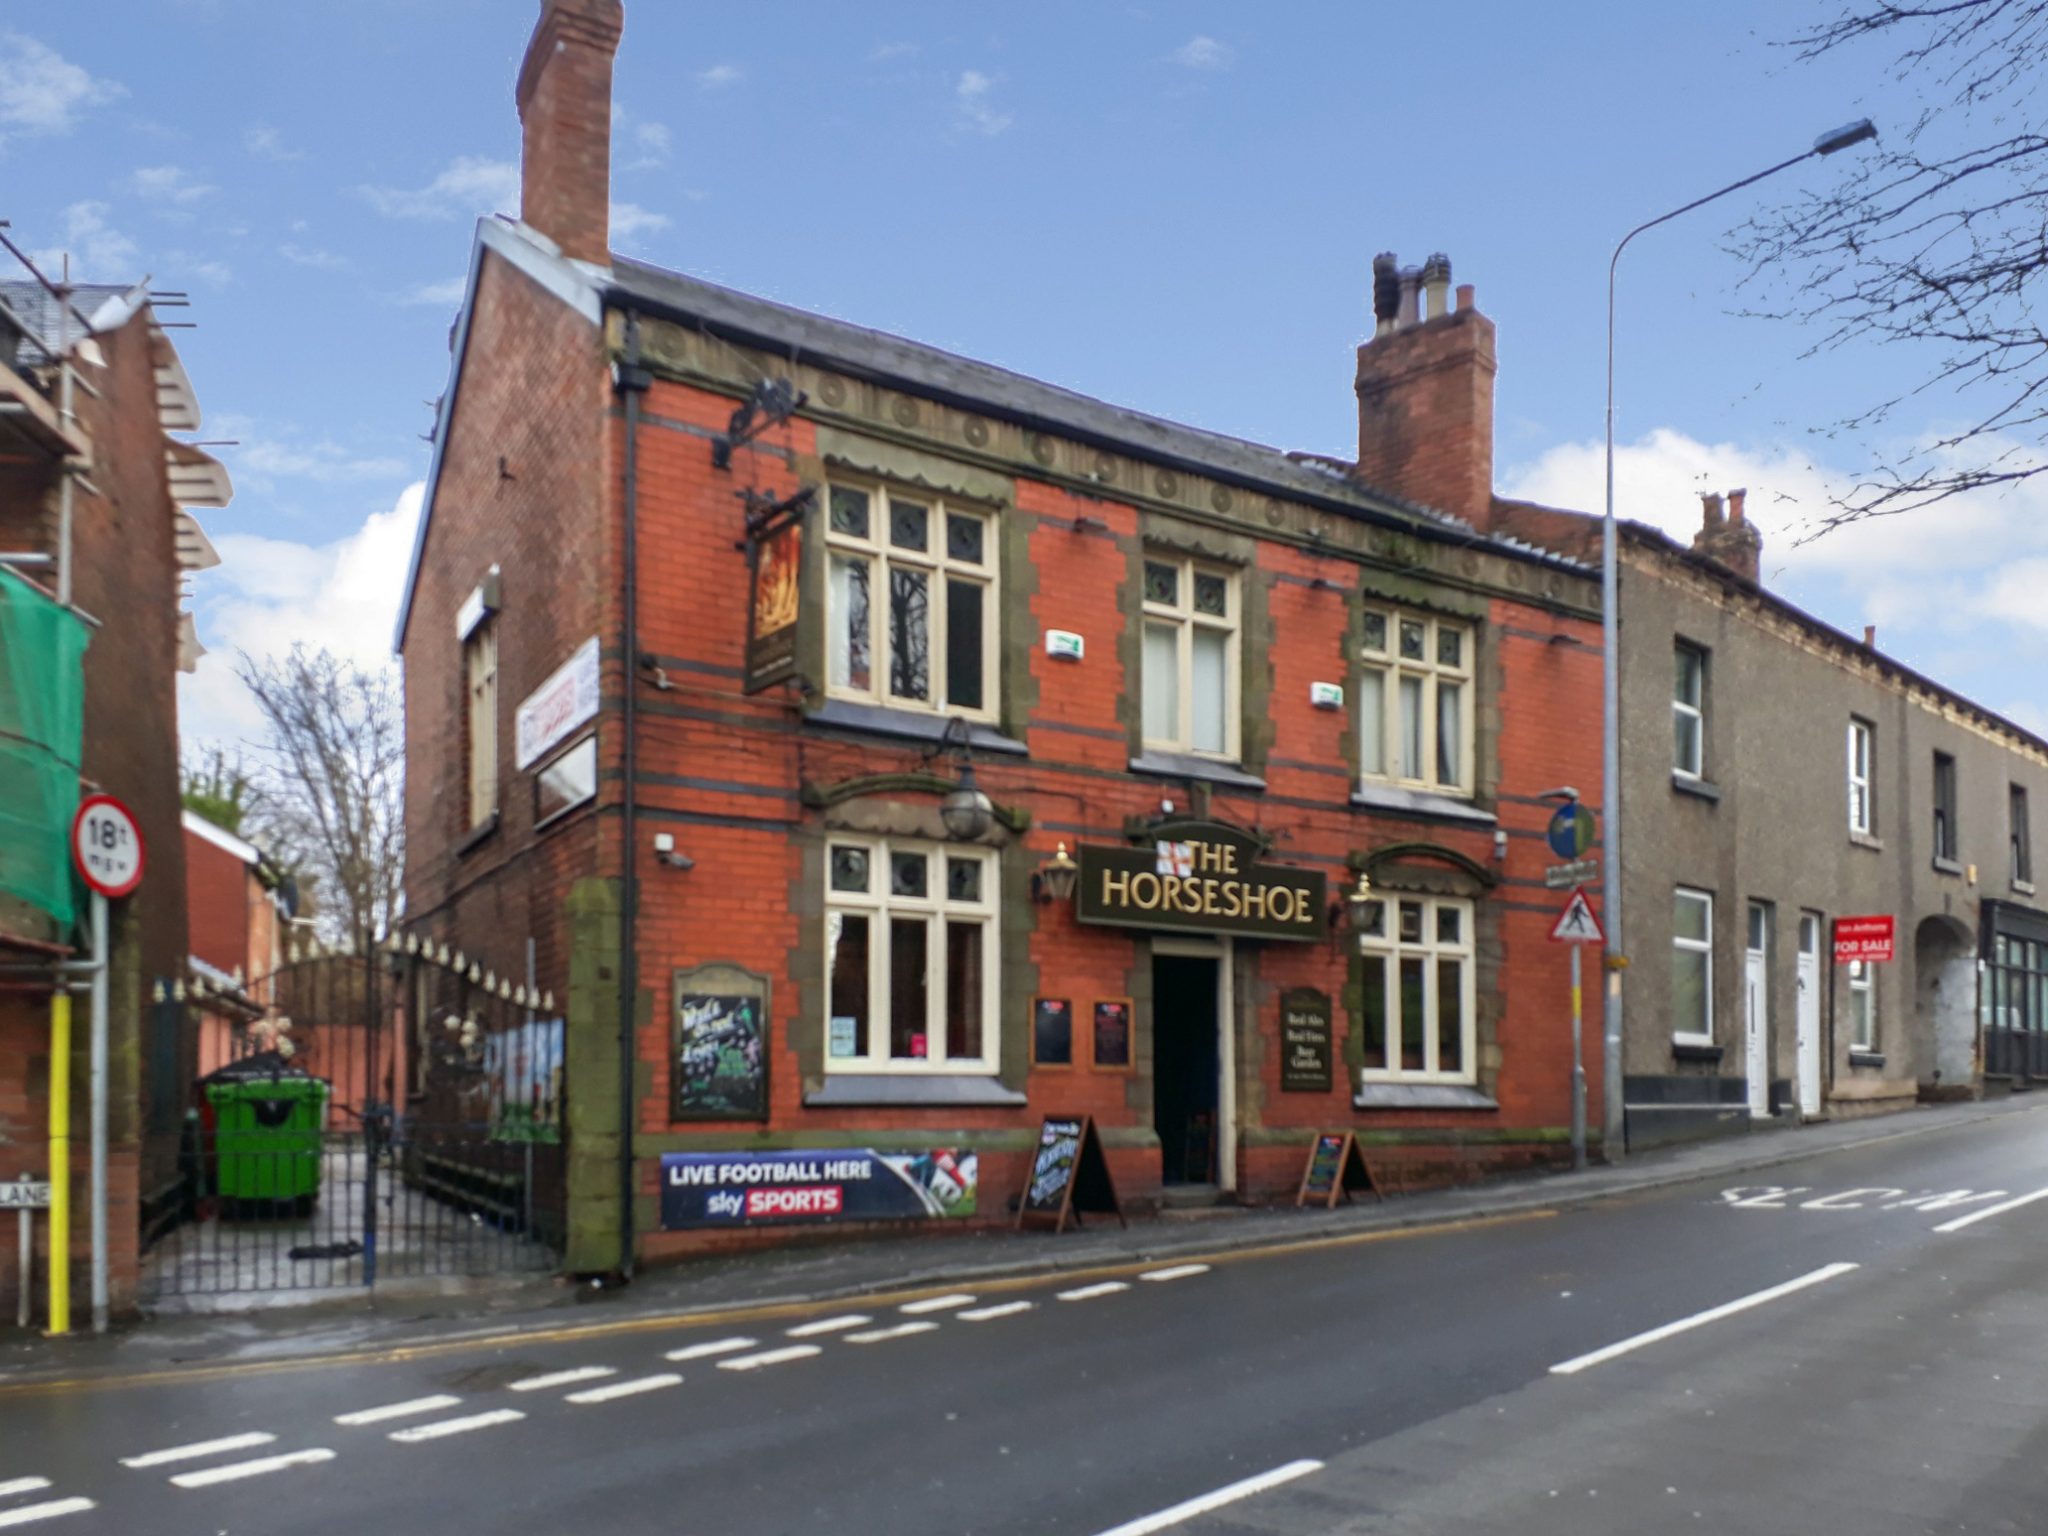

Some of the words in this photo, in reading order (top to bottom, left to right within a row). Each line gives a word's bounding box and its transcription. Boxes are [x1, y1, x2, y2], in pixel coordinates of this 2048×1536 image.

[1185, 840, 1238, 874] THE
[1102, 868, 1313, 923] HORSESHOE
[1834, 940, 1859, 953] FOR
[1861, 939, 1891, 952] SALE
[670, 1165, 715, 1186] LIVE
[718, 1161, 820, 1184] FOOTBALL
[823, 1159, 872, 1180] HERE
[708, 1191, 744, 1217] sky
[749, 1189, 839, 1214] SPORTS
